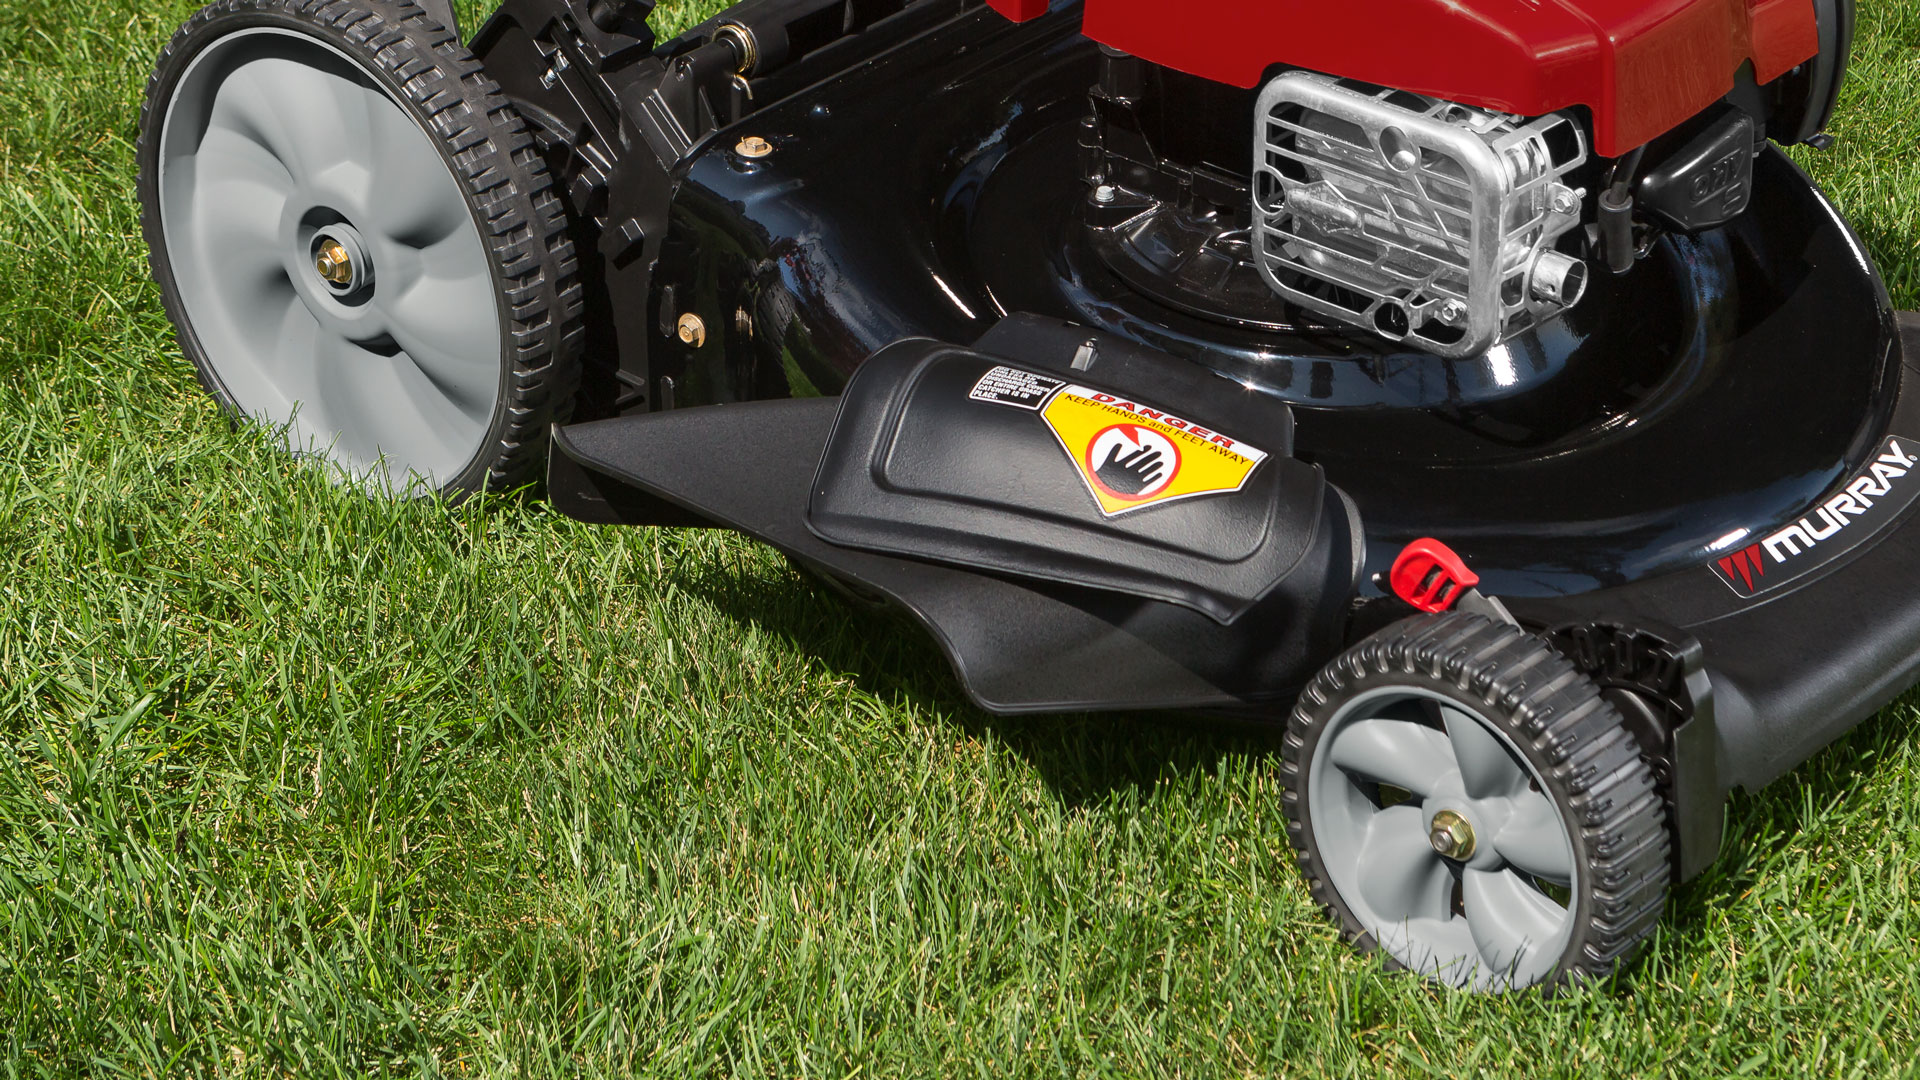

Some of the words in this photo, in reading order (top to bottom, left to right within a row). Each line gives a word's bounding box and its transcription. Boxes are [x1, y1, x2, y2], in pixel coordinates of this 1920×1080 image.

[977, 384, 1011, 396] CATCHER
[986, 375, 1026, 387] DISCHARGE
[1026, 383, 1051, 393] COVER
[993, 381, 1019, 391] ENTIRE
[1018, 386, 1043, 396] GRASS
[973, 389, 998, 400] PLACE.
[1090, 393, 1235, 448] DANGER
[1065, 393, 1101, 408] KEEP
[1102, 404, 1147, 424] HANDS
[1148, 420, 1172, 433] and
[1173, 429, 1205, 446] FEET
[1208, 444, 1249, 465] AWAY
